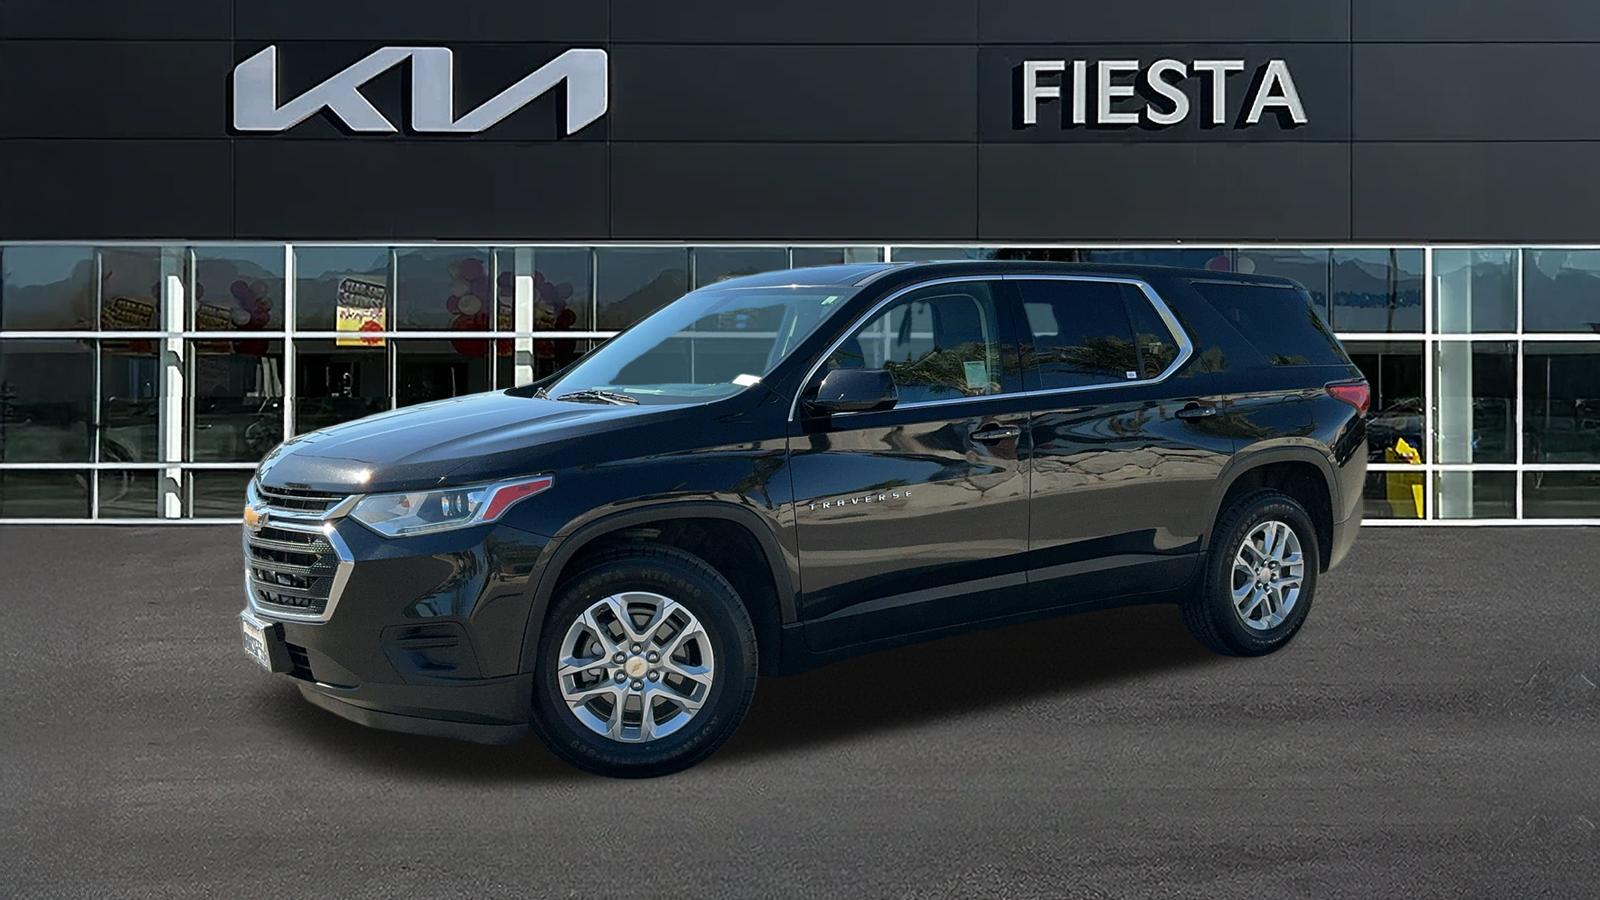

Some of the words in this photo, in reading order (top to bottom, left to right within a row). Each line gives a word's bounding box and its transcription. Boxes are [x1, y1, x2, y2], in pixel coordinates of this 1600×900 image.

[233, 45, 609, 134] KIA
[1022, 59, 1308, 126] FIESTA
[809, 490, 912, 511] TRAVERSE
